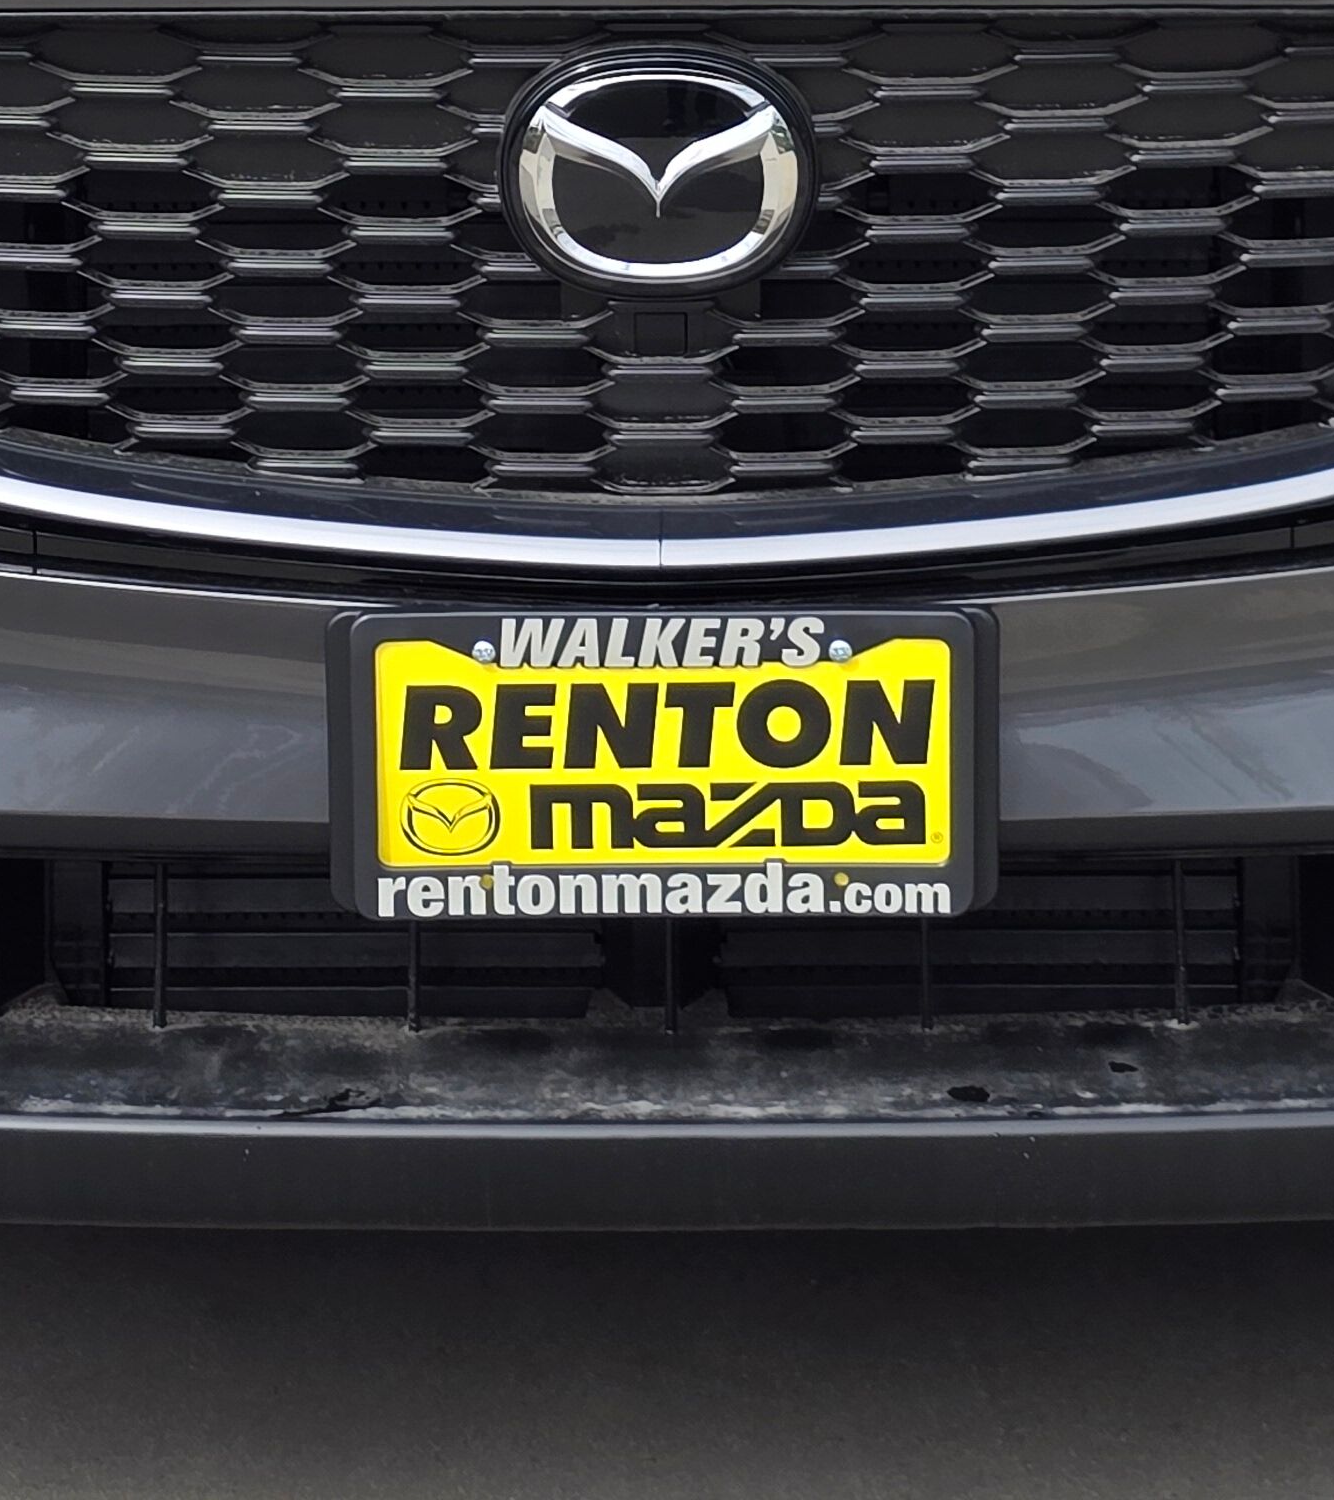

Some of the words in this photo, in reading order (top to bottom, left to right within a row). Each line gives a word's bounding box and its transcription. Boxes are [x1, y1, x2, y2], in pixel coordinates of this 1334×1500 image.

[499, 616, 825, 668] WALKER'S
[399, 679, 936, 771] RENTON
[530, 780, 926, 850] mazda
[377, 864, 951, 918] rentonmazda.com
